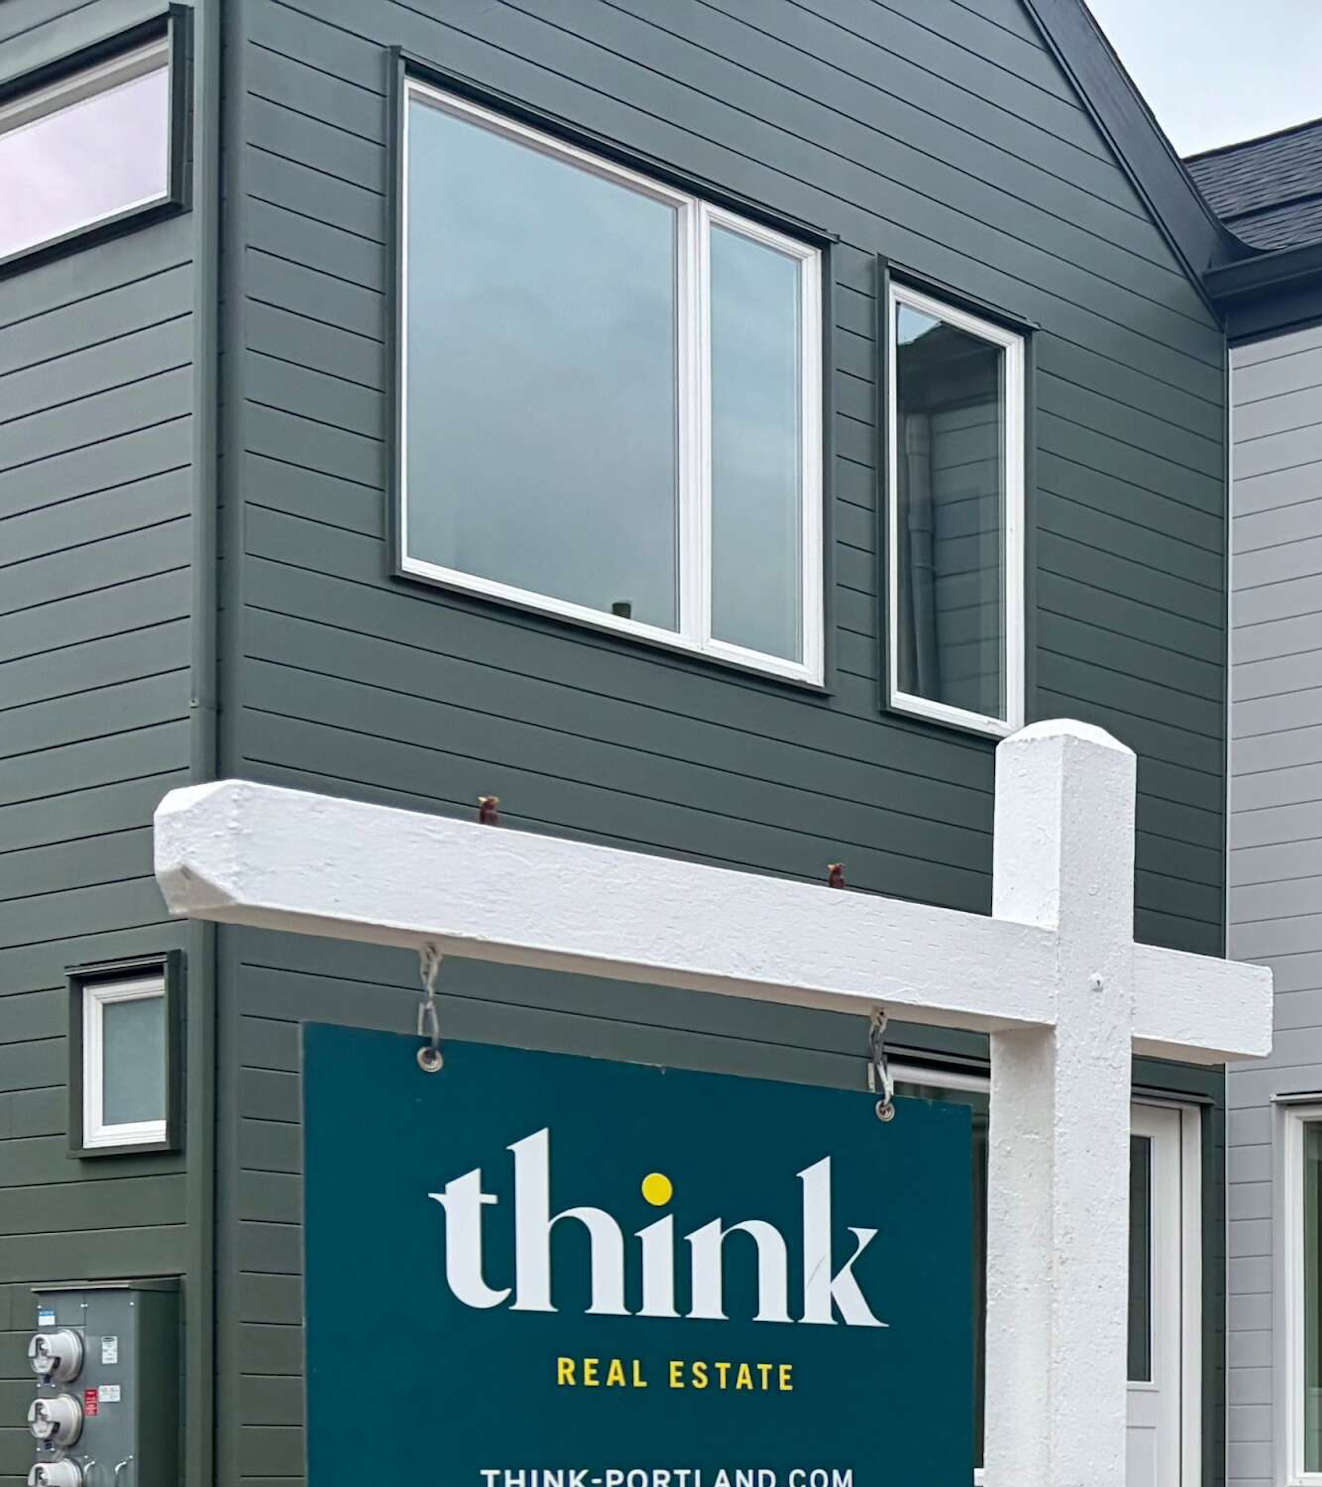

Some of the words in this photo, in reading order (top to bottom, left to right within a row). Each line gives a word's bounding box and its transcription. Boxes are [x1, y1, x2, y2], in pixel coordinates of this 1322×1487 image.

[428, 1126, 890, 1327] think
[557, 1357, 648, 1388] REAL
[669, 1360, 794, 1391] ESTATE
